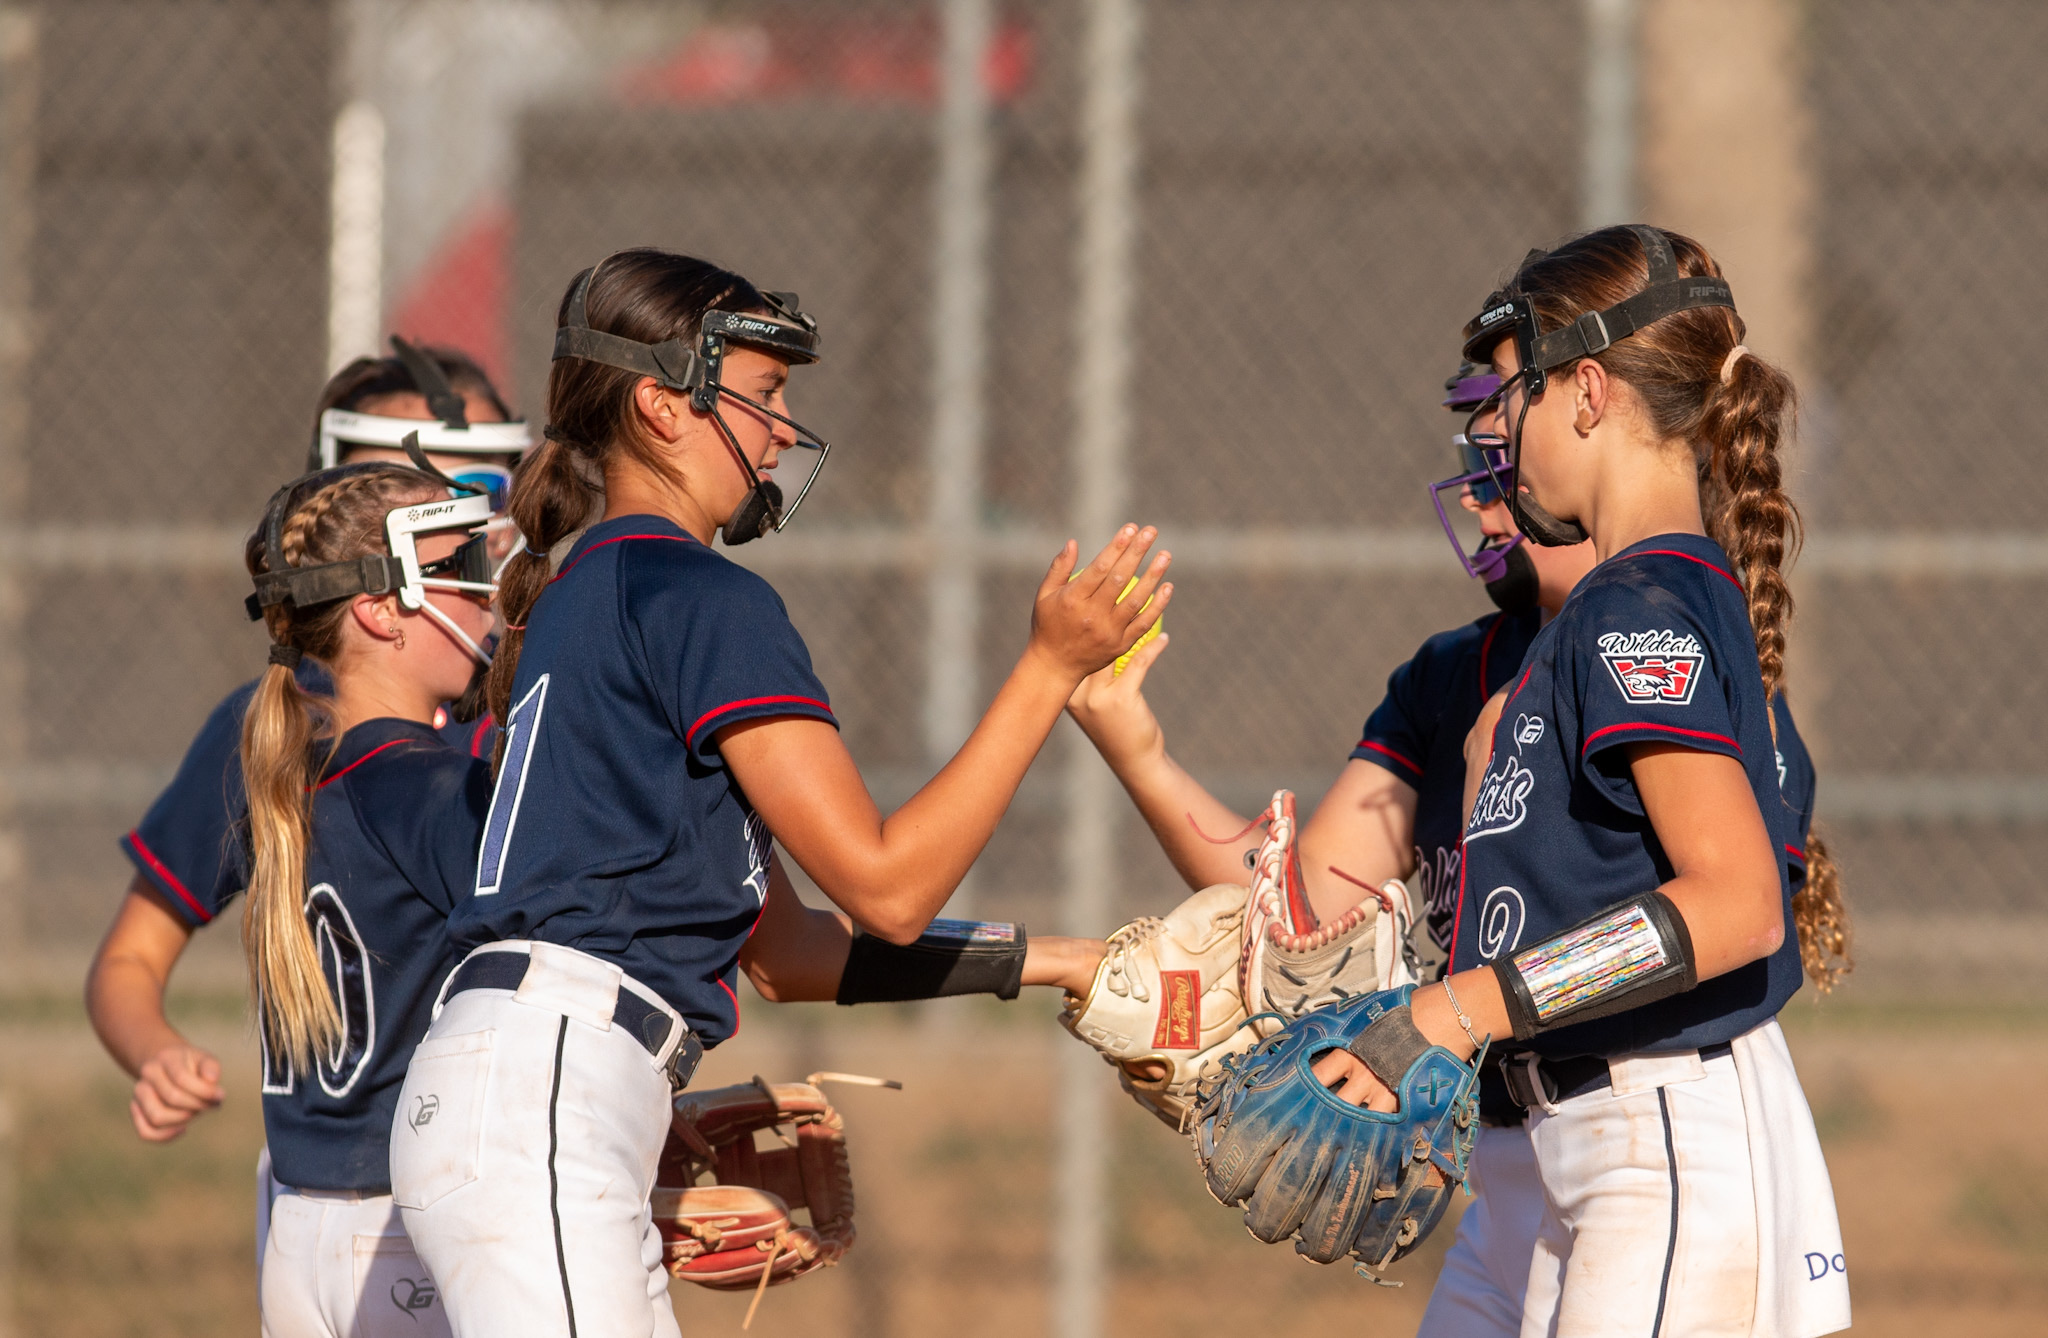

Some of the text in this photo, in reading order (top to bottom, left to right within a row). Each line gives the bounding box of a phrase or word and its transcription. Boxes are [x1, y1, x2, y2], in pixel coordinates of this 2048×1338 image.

[739, 319, 780, 335] RIP-IT
[422, 504, 456, 518] RIP-IT
[1597, 628, 1702, 655] Wildcats
